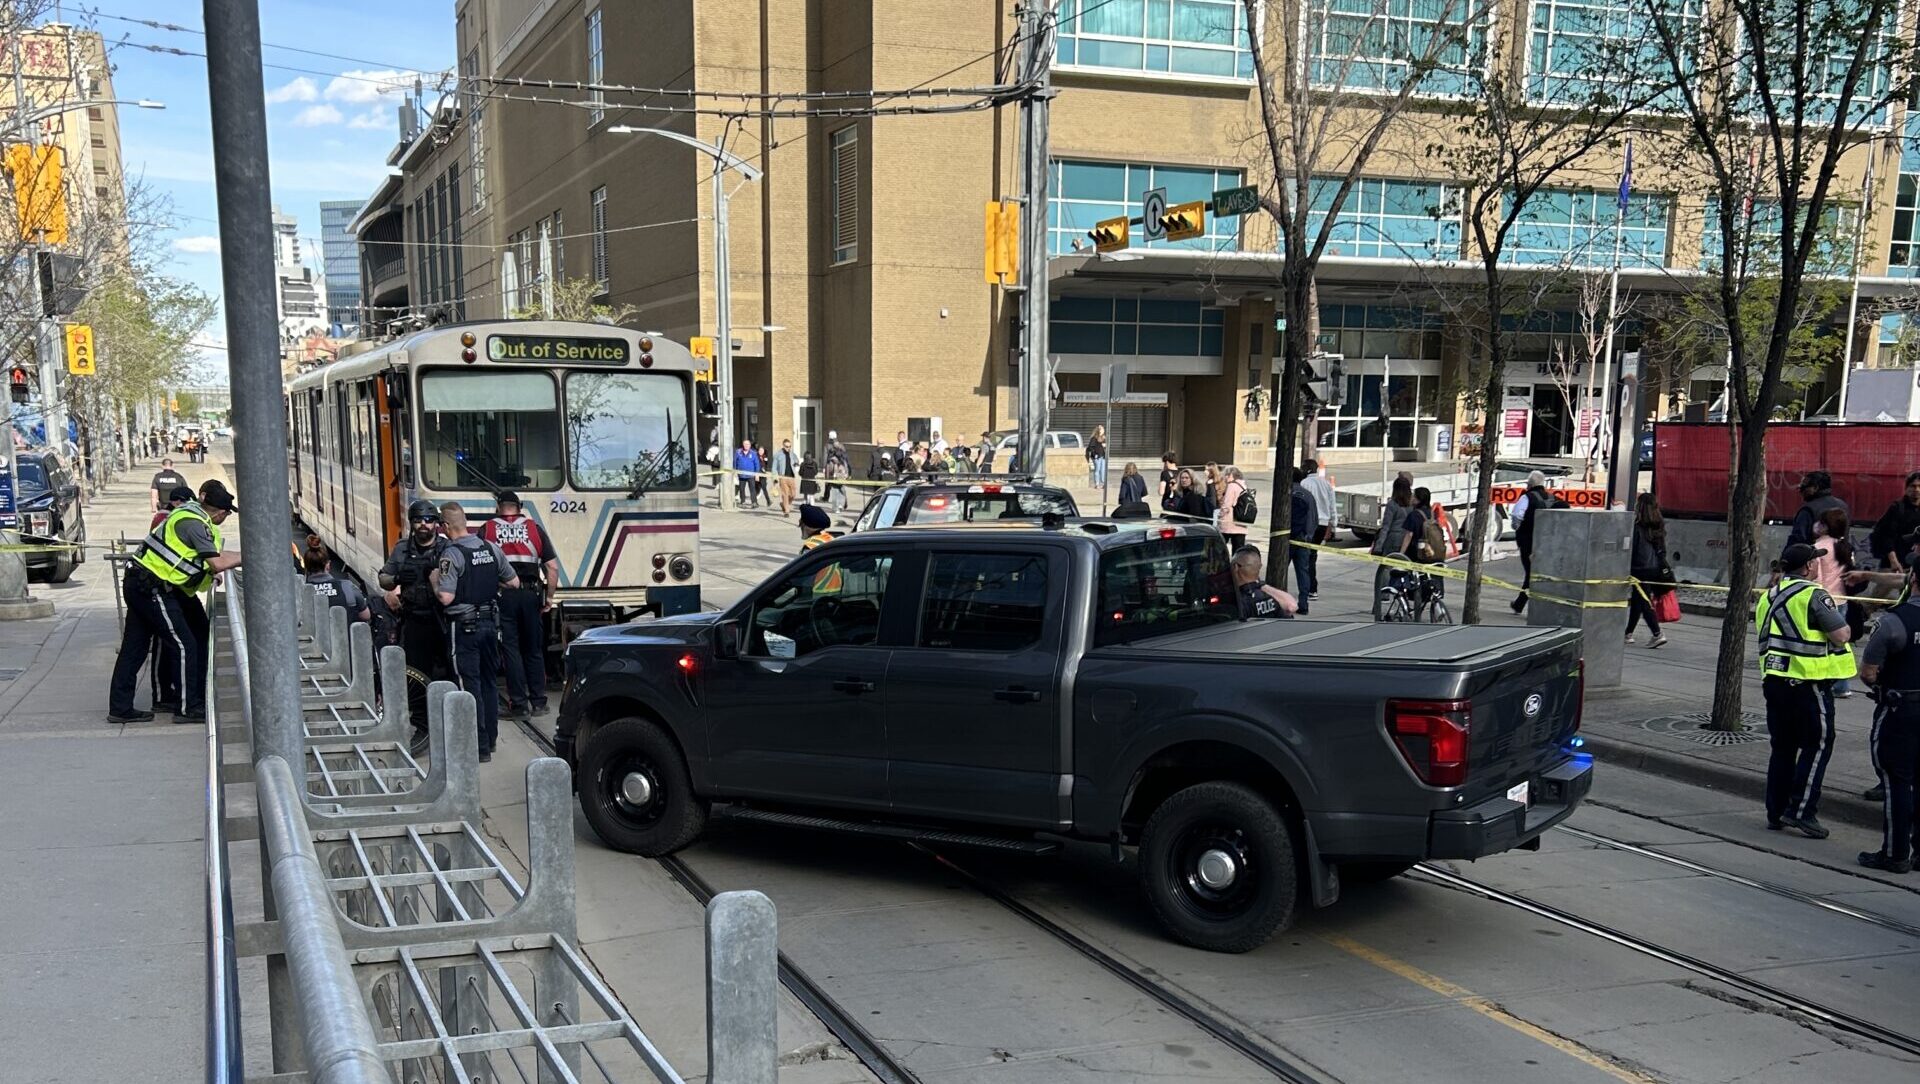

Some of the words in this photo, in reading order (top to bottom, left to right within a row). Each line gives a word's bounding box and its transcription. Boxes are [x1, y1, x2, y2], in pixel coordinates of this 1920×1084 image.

[491, 340, 527, 358] Out
[531, 342, 551, 358] of
[555, 342, 624, 360] Service
[550, 501, 587, 514] 2024
[495, 528, 529, 539] POLICE
[498, 537, 528, 545] TRAFFIC
[472, 550, 490, 559] PEACE
[471, 556, 494, 566] OFFICER
[1255, 598, 1276, 616] POLICE
